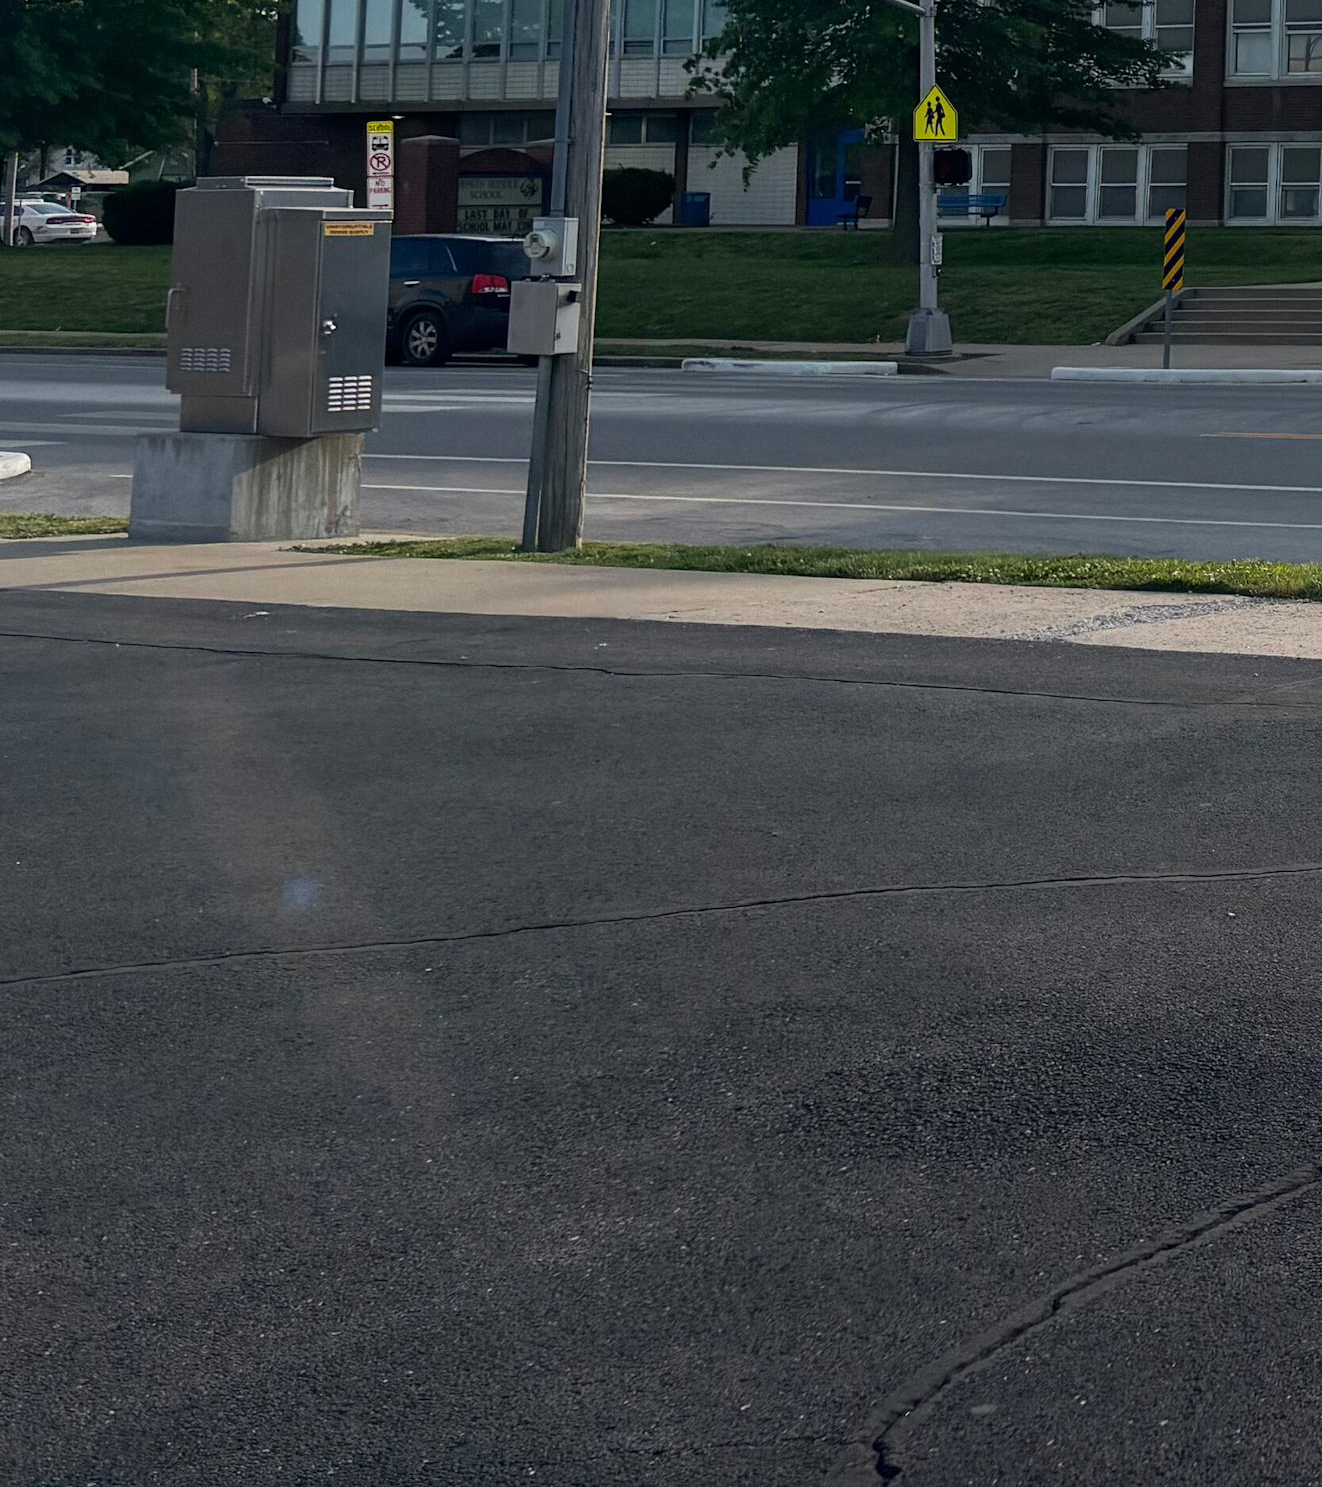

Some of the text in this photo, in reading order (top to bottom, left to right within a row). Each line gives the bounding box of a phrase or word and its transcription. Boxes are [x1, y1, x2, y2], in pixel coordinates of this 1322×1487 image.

[464, 208, 488, 220] LAST
[493, 208, 511, 220] DAY
[493, 220, 513, 232] MAY
